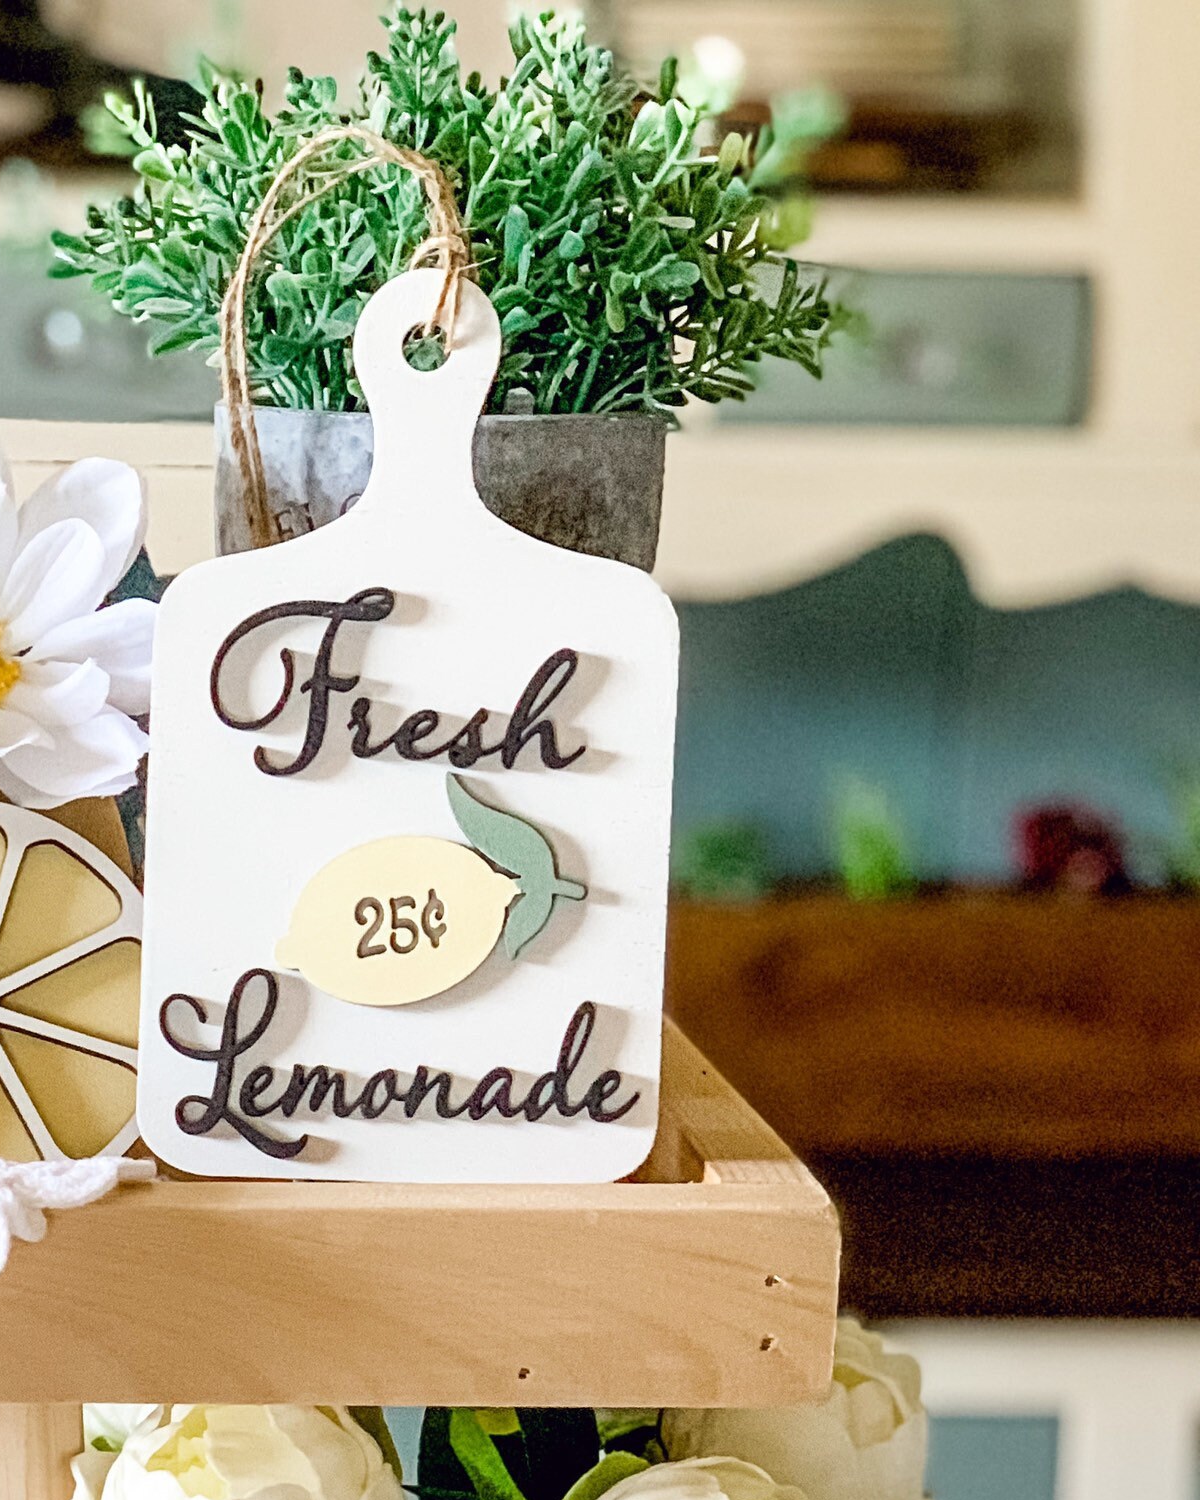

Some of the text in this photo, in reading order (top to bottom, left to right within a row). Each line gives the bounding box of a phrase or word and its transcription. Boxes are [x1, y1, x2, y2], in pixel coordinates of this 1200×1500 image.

[210, 586, 587, 777] Fresh
[354, 888, 448, 959] 25¢
[159, 968, 642, 1160] Lemonade
